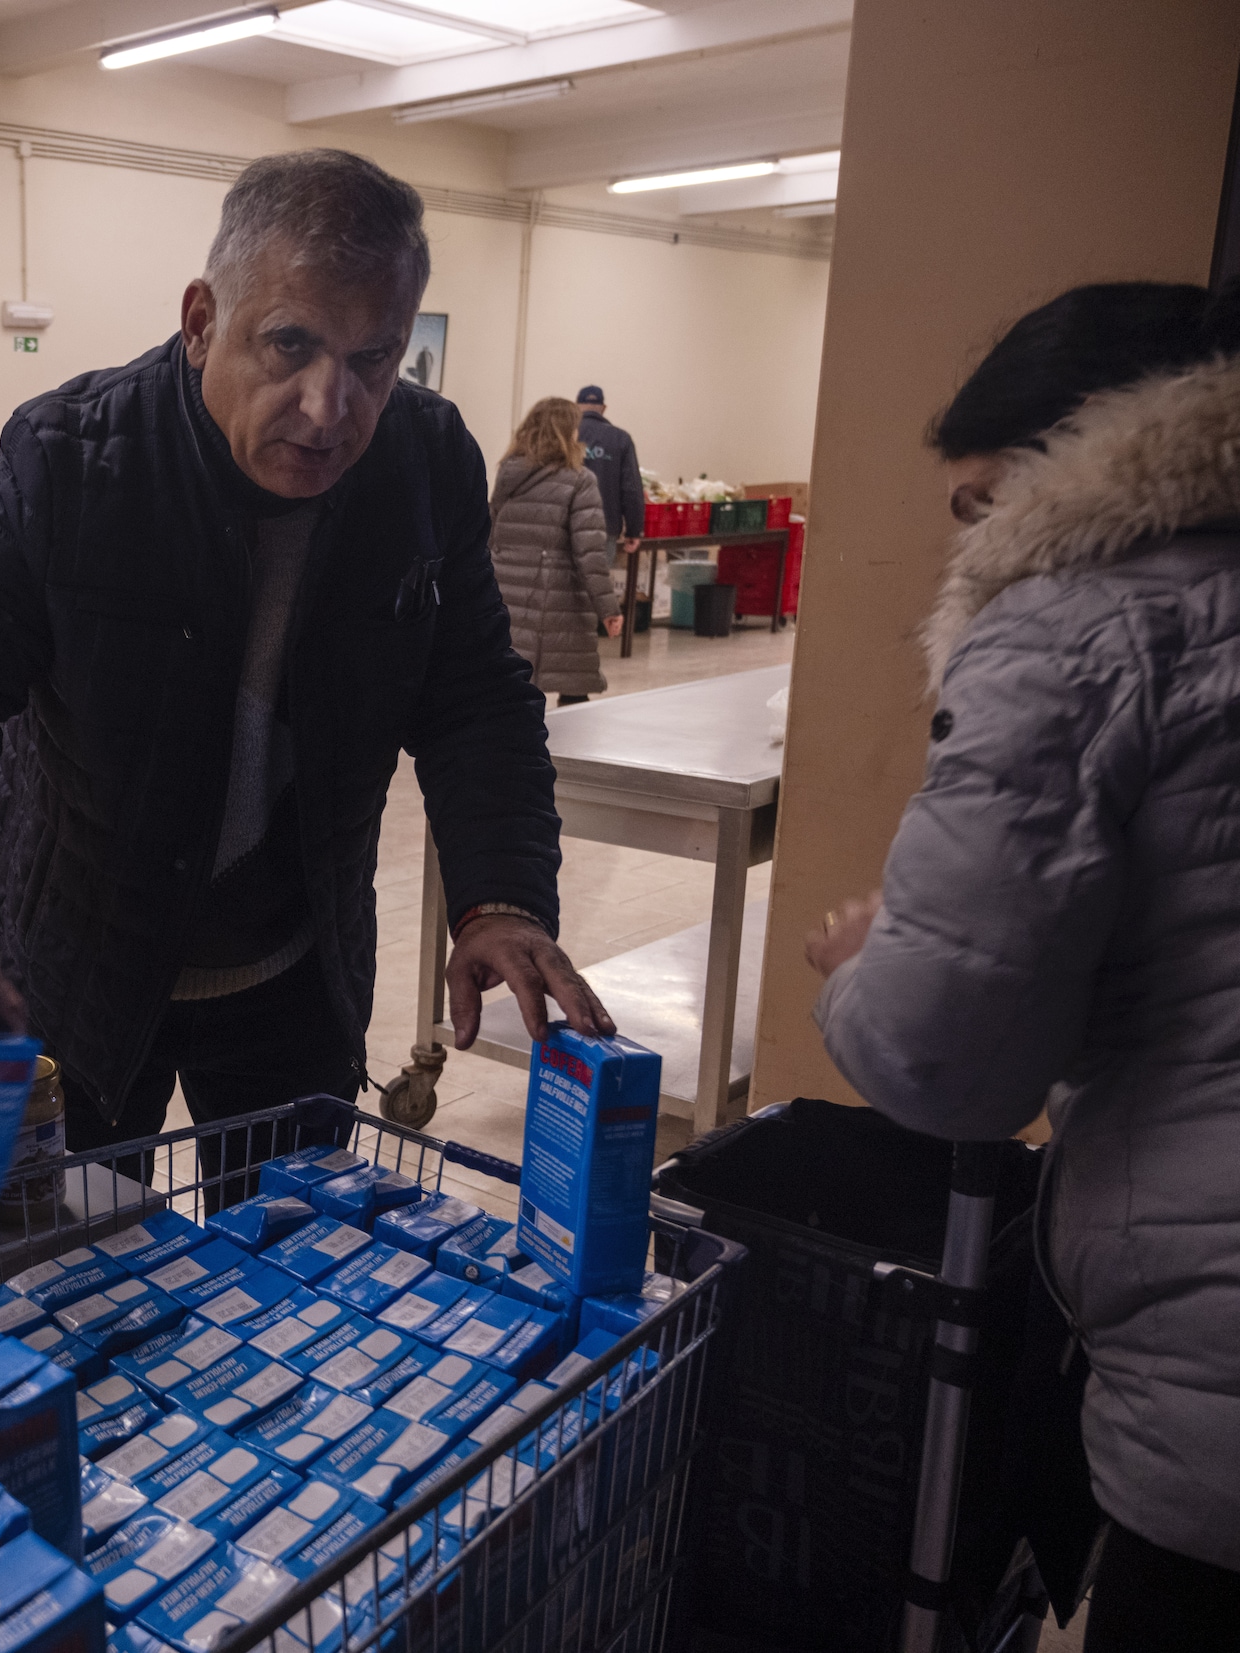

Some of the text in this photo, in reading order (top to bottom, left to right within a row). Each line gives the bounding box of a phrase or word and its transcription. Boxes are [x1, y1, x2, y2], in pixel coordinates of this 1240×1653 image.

[135, 1249, 152, 1261] LAIT
[143, 1238, 191, 1263] HALFVOLLE MELK
[189, 1284, 205, 1295] LAIT
[198, 1272, 246, 1297] HALFVOLLE MELK
[302, 1346, 318, 1358] LAIT
[312, 1328, 361, 1361] HALFVOLLE MELK
[185, 1357, 237, 1391] HALFVOLLE MELK
[231, 1362, 248, 1376] LAIT
[84, 1426, 98, 1436] LAIT
[371, 1428, 388, 1444] LAIT
[327, 1423, 376, 1465] HALFVOLLE MELK
[150, 1471, 166, 1484] LAIT
[161, 1448, 216, 1488] HALFVOLLE MELK
[228, 1479, 283, 1527] HALFVOLLE MELK
[311, 1518, 366, 1566] HALFVOLLE MELK
[298, 1547, 316, 1562] LAIT
[158, 1559, 218, 1611] HALFVOLLE MELK
[213, 1566, 231, 1585] LAIT
